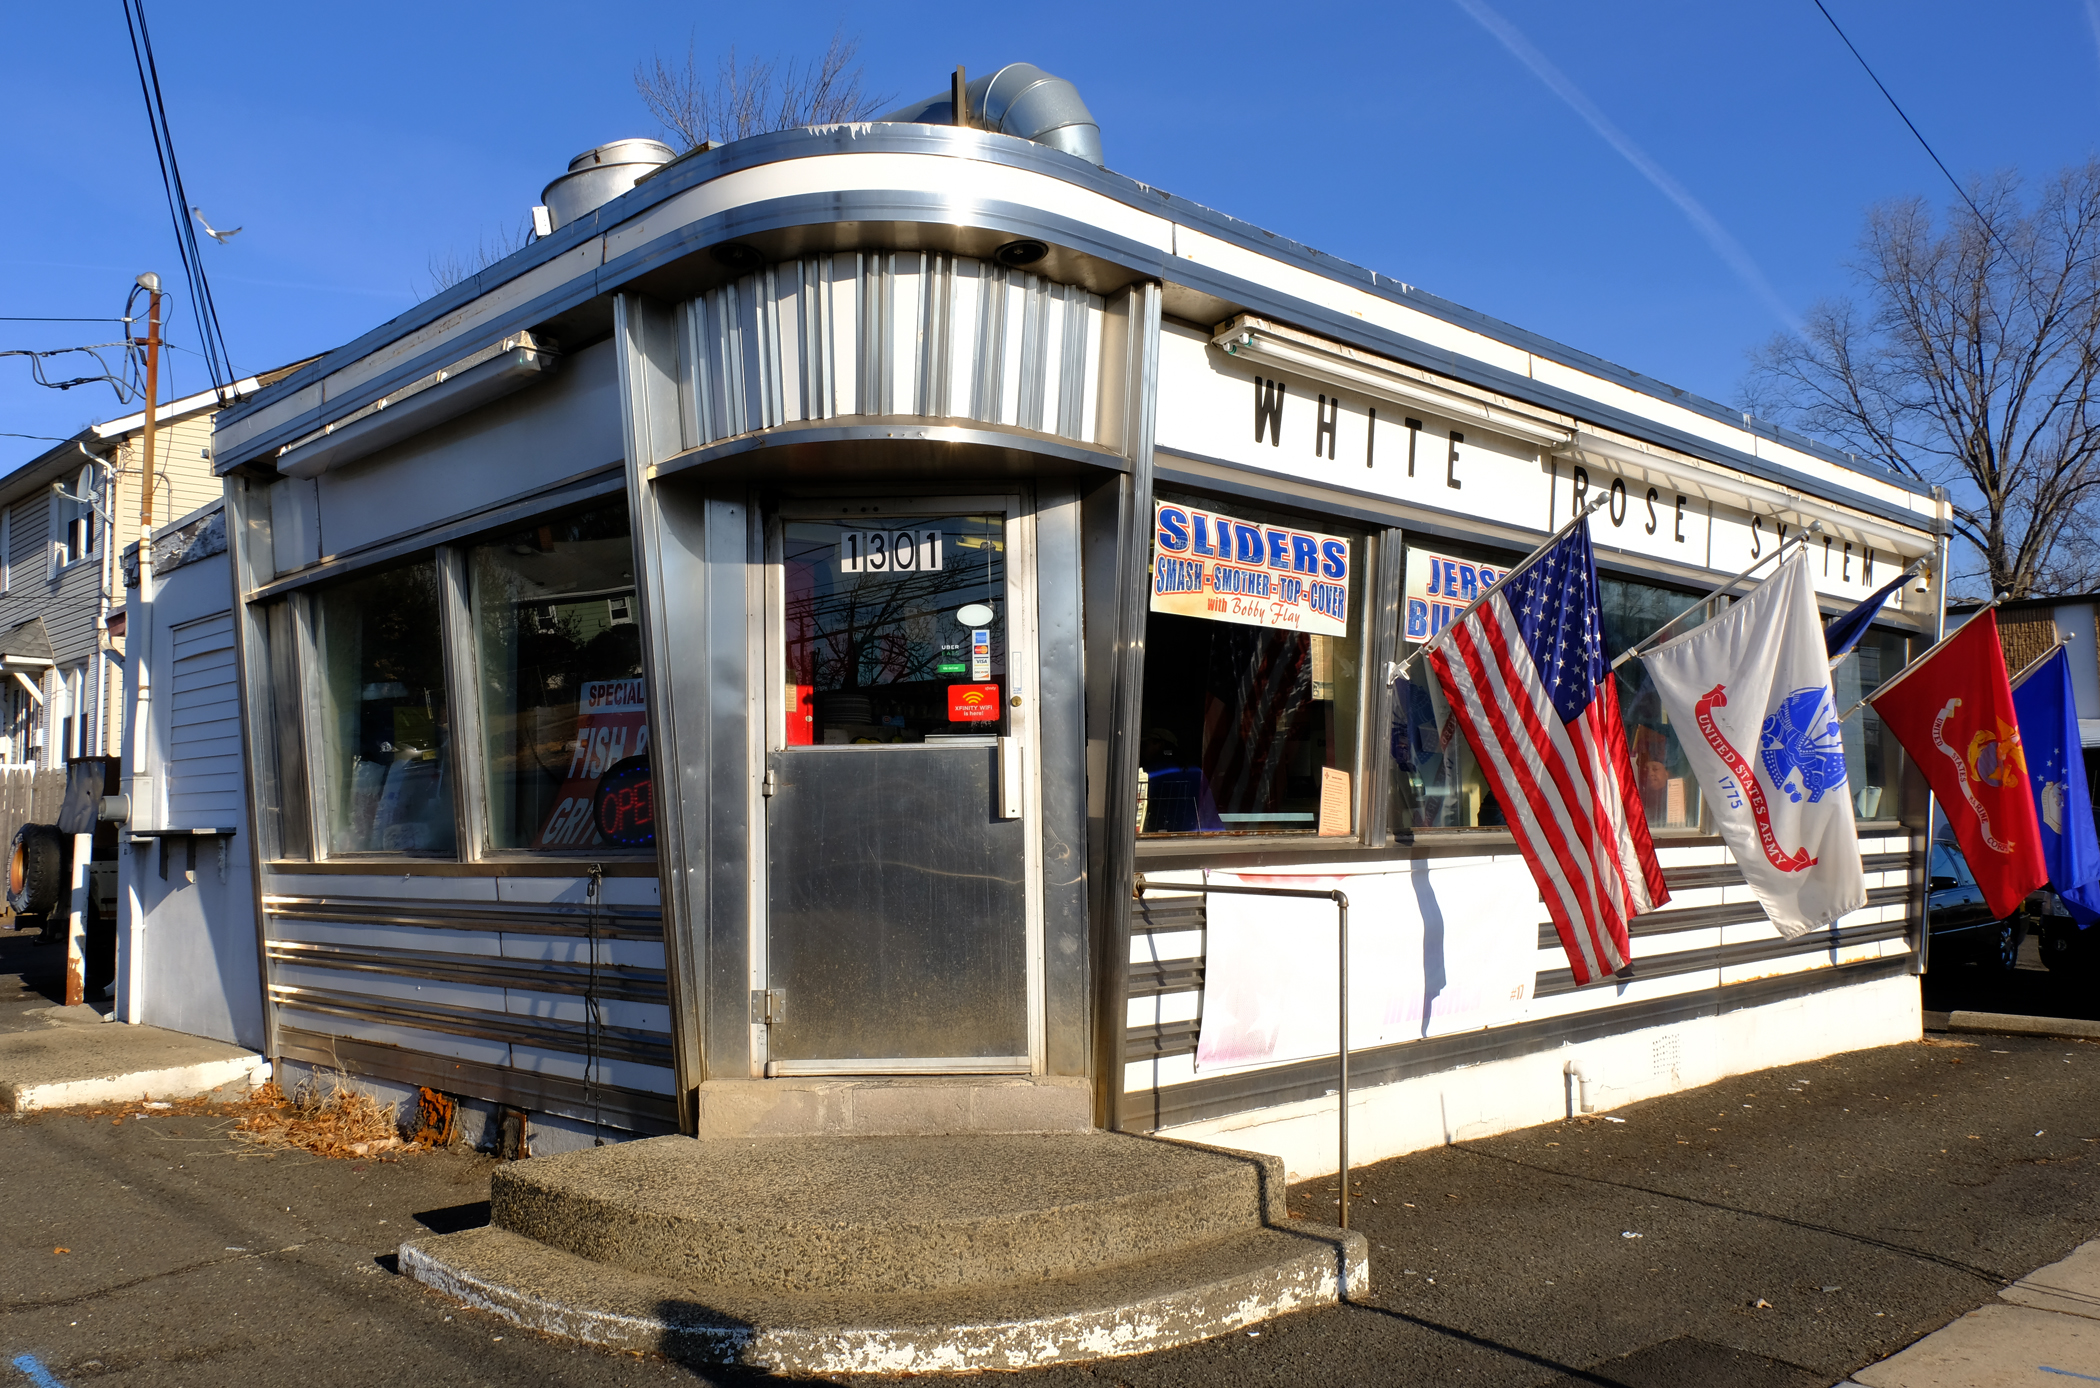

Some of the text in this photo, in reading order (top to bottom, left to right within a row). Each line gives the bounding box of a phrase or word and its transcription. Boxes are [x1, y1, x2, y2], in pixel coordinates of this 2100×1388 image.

[1254, 375, 1875, 588] WHITE ROSE SYTEM
[847, 531, 938, 571] 1301
[1158, 507, 1346, 580] SLIDERS
[1155, 555, 1204, 595] SMASH
[1213, 564, 1270, 598] SMOTHER
[1279, 576, 1301, 605] TOP
[1309, 581, 1346, 621] COVER
[1426, 555, 1508, 601] JERS
[1207, 597, 1301, 629] with Bobby Flay
[1405, 596, 1466, 639] BU
[568, 726, 628, 780] FISH
[1933, 717, 1944, 747] UNITED
[1951, 752, 1967, 783] STATES
[1968, 795, 1989, 824] MARINE
[1698, 714, 1787, 866] UNITED STATES ARMY
[1718, 775, 1744, 809] 1775
[1510, 984, 1525, 1001] #17
